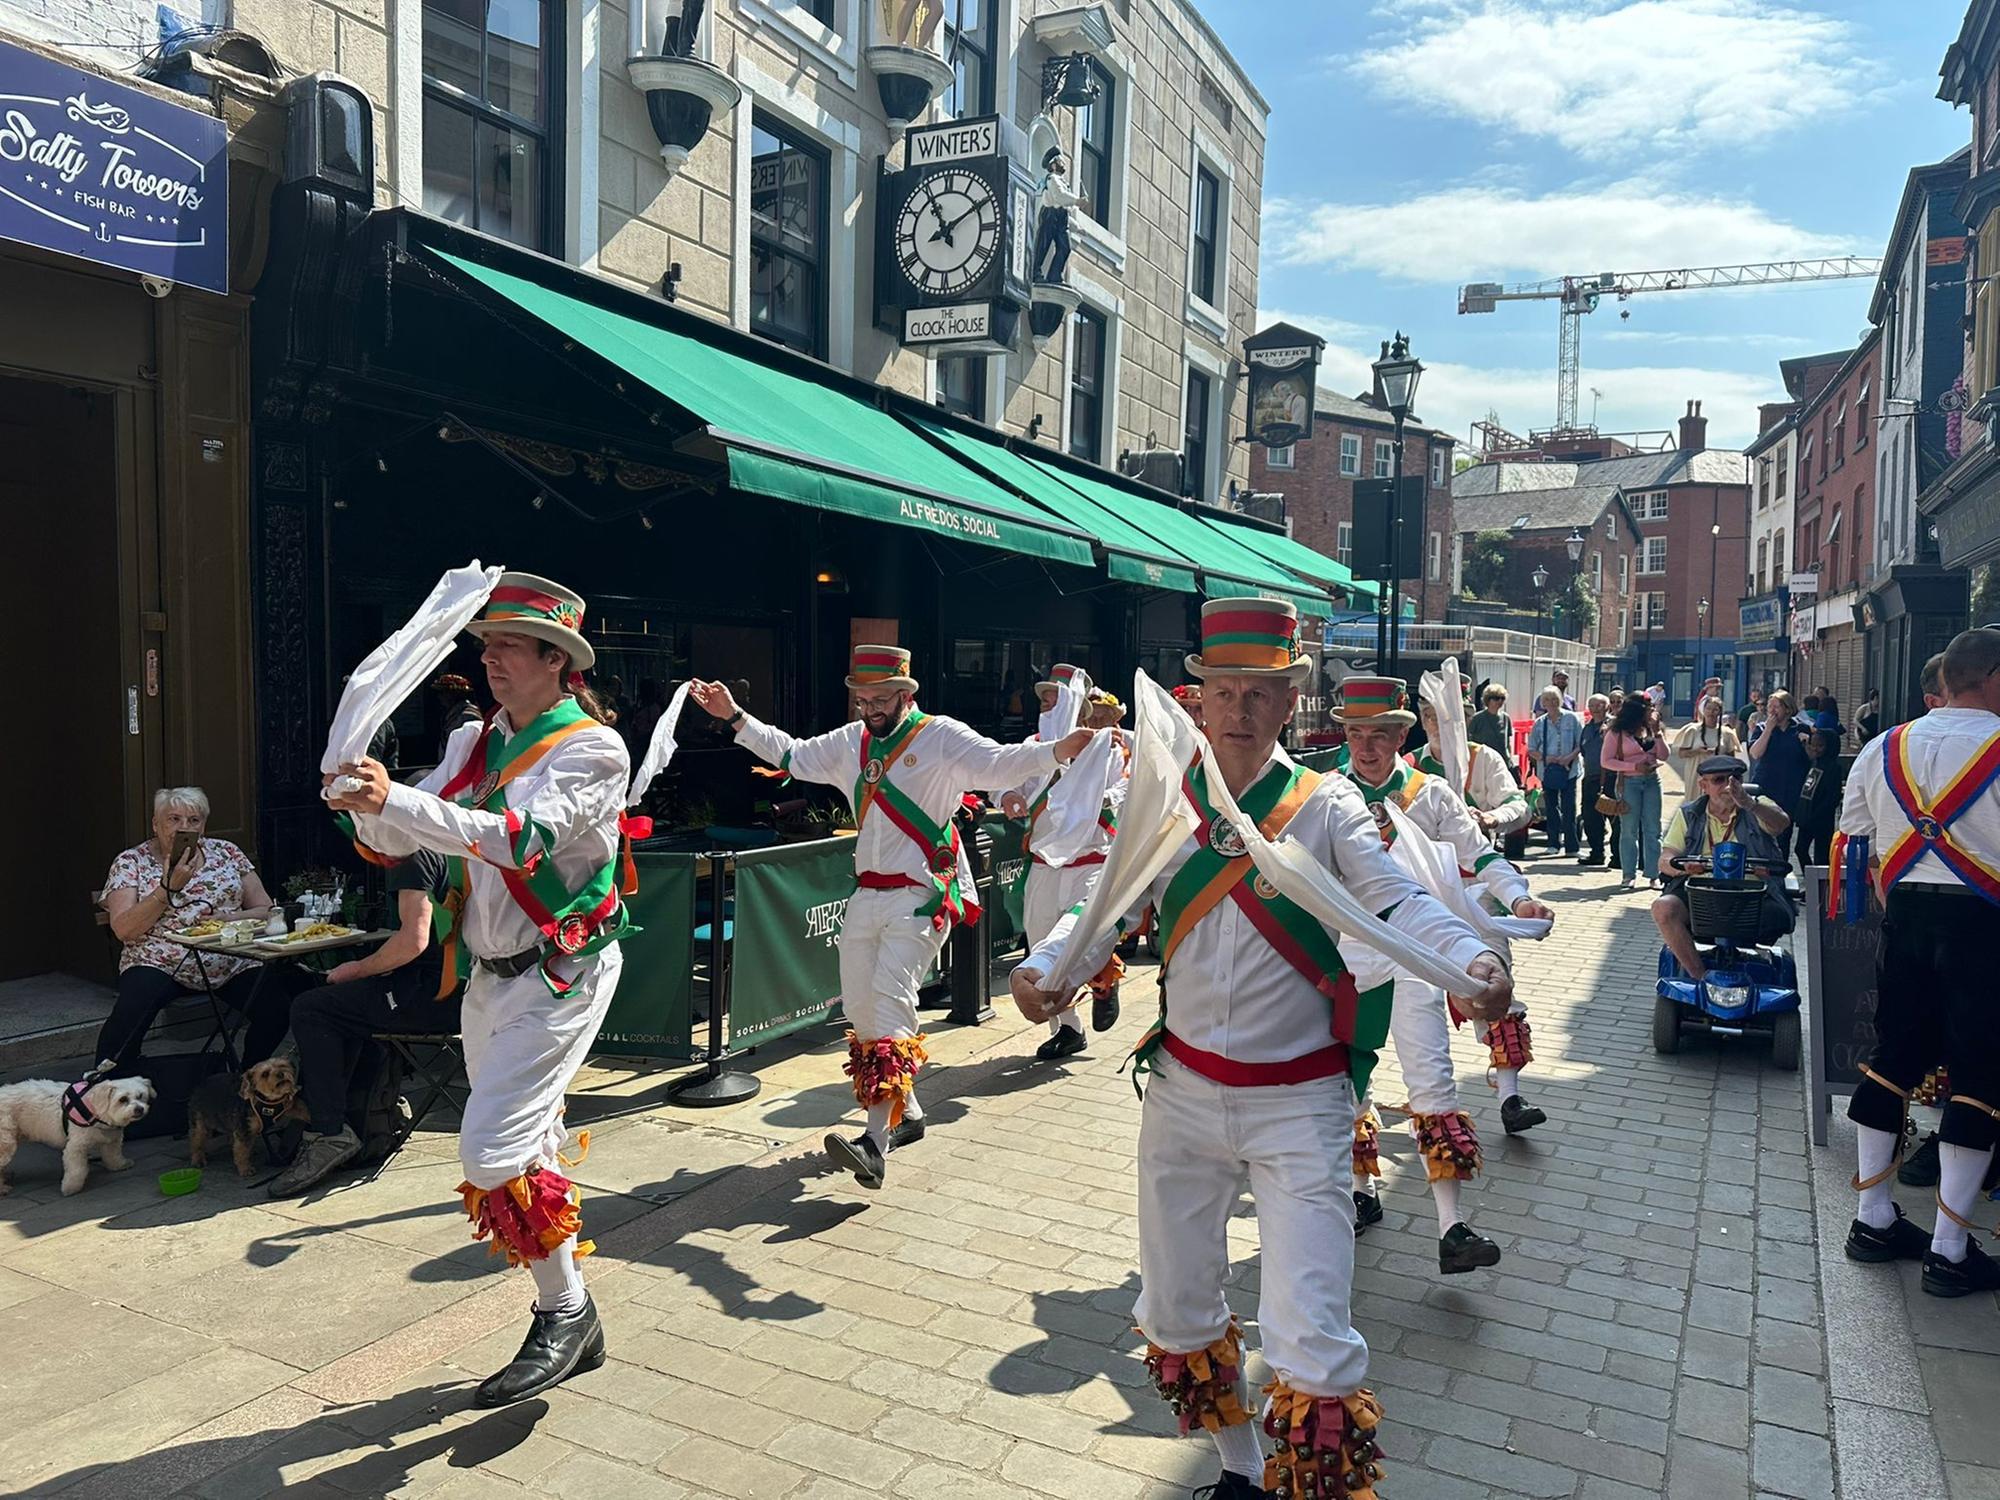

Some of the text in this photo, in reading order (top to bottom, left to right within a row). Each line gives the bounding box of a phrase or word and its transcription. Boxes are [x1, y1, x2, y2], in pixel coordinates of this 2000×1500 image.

[917, 126, 991, 159] WINTER'S
[0, 110, 204, 210] Salty Towers
[74, 191, 136, 219] FISH BAR
[941, 309, 954, 319] THE
[911, 316, 985, 336] CLOCK HOUSE
[1255, 347, 1307, 358] WINTER'S
[1297, 694, 1328, 712] THE
[736, 1021, 769, 1037] SOCIAL
[796, 1002, 825, 1018] SOCIAL
[597, 1032, 680, 1045] CIAL COCKTAILS
